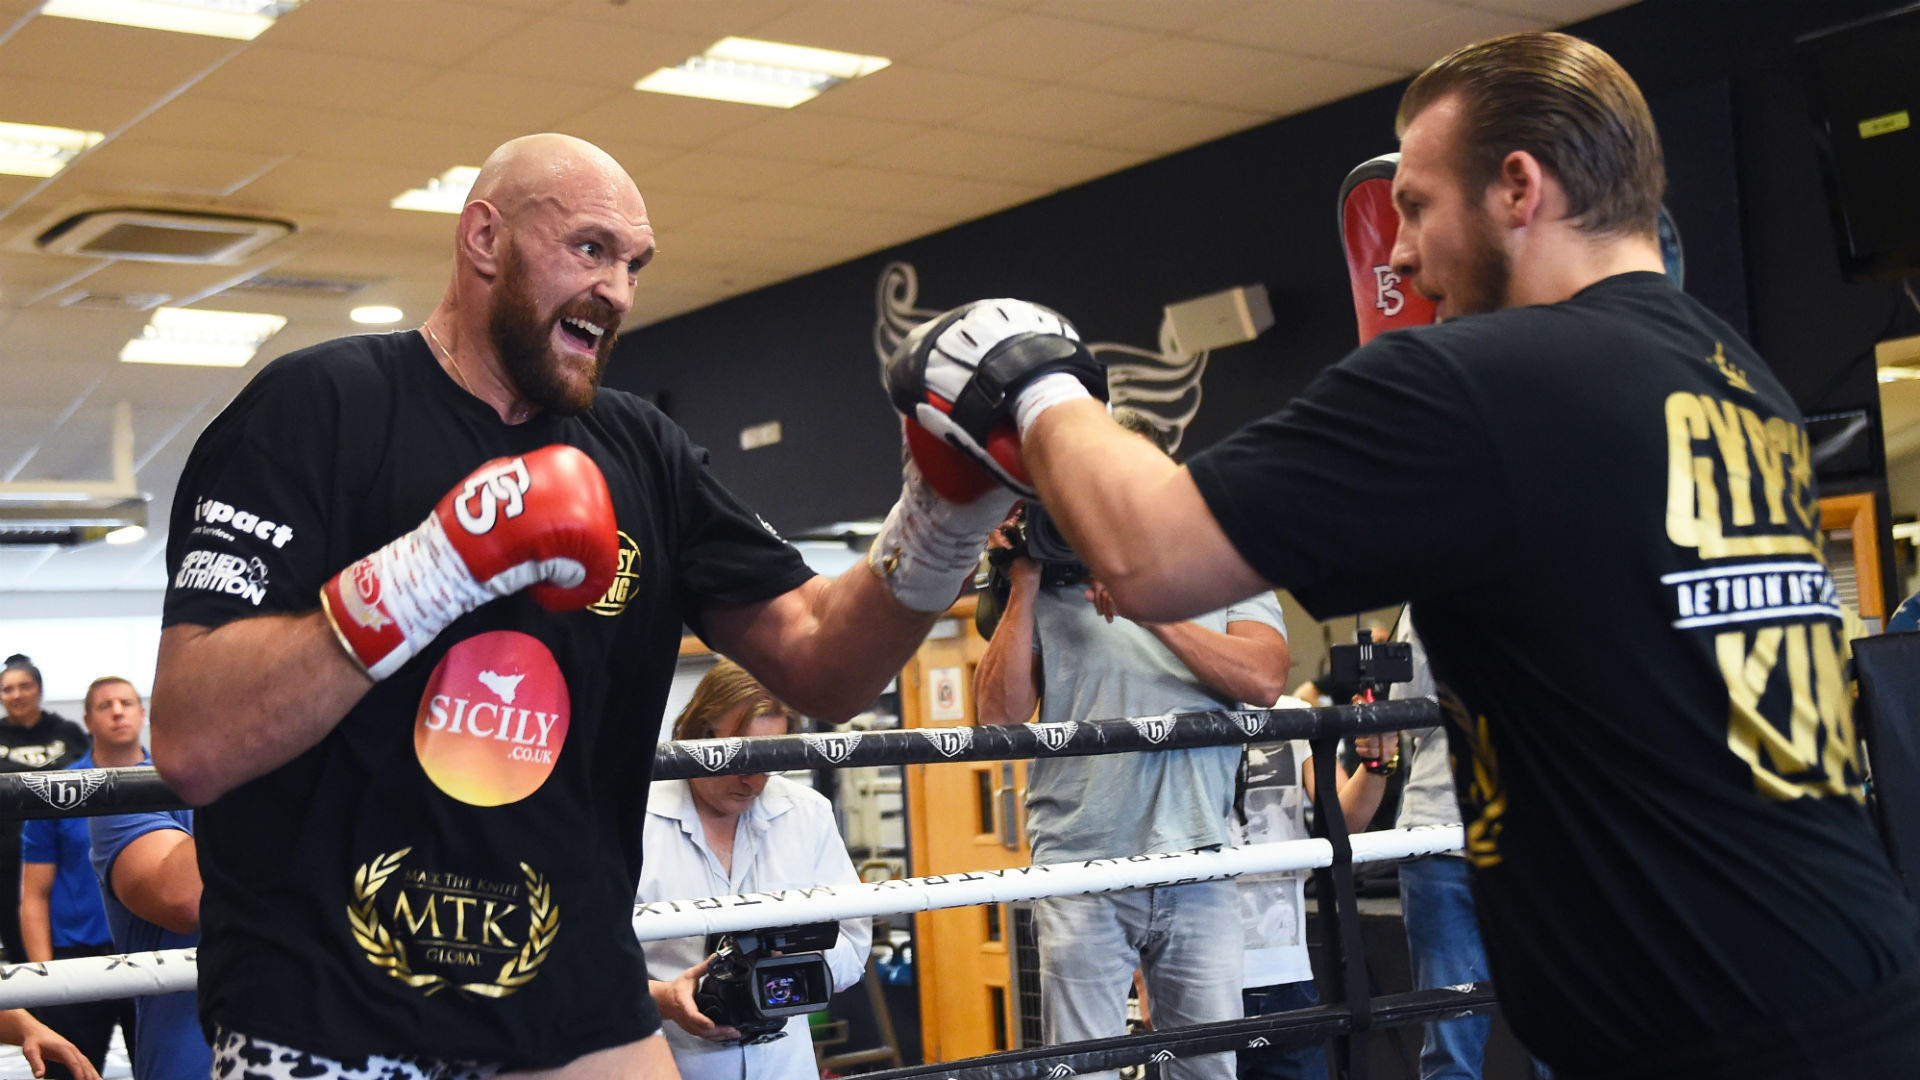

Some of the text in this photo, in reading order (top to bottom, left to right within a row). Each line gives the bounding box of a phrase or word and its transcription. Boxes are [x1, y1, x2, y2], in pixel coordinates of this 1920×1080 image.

[1664, 390, 1828, 563] GYPS
[182, 550, 247, 577] APPLIED
[424, 694, 559, 747] SICILY
[1715, 622, 1866, 806] KIN
[508, 746, 552, 764] .CO.UK
[393, 890, 518, 948] MTK
[426, 948, 483, 966] GLOBAL
